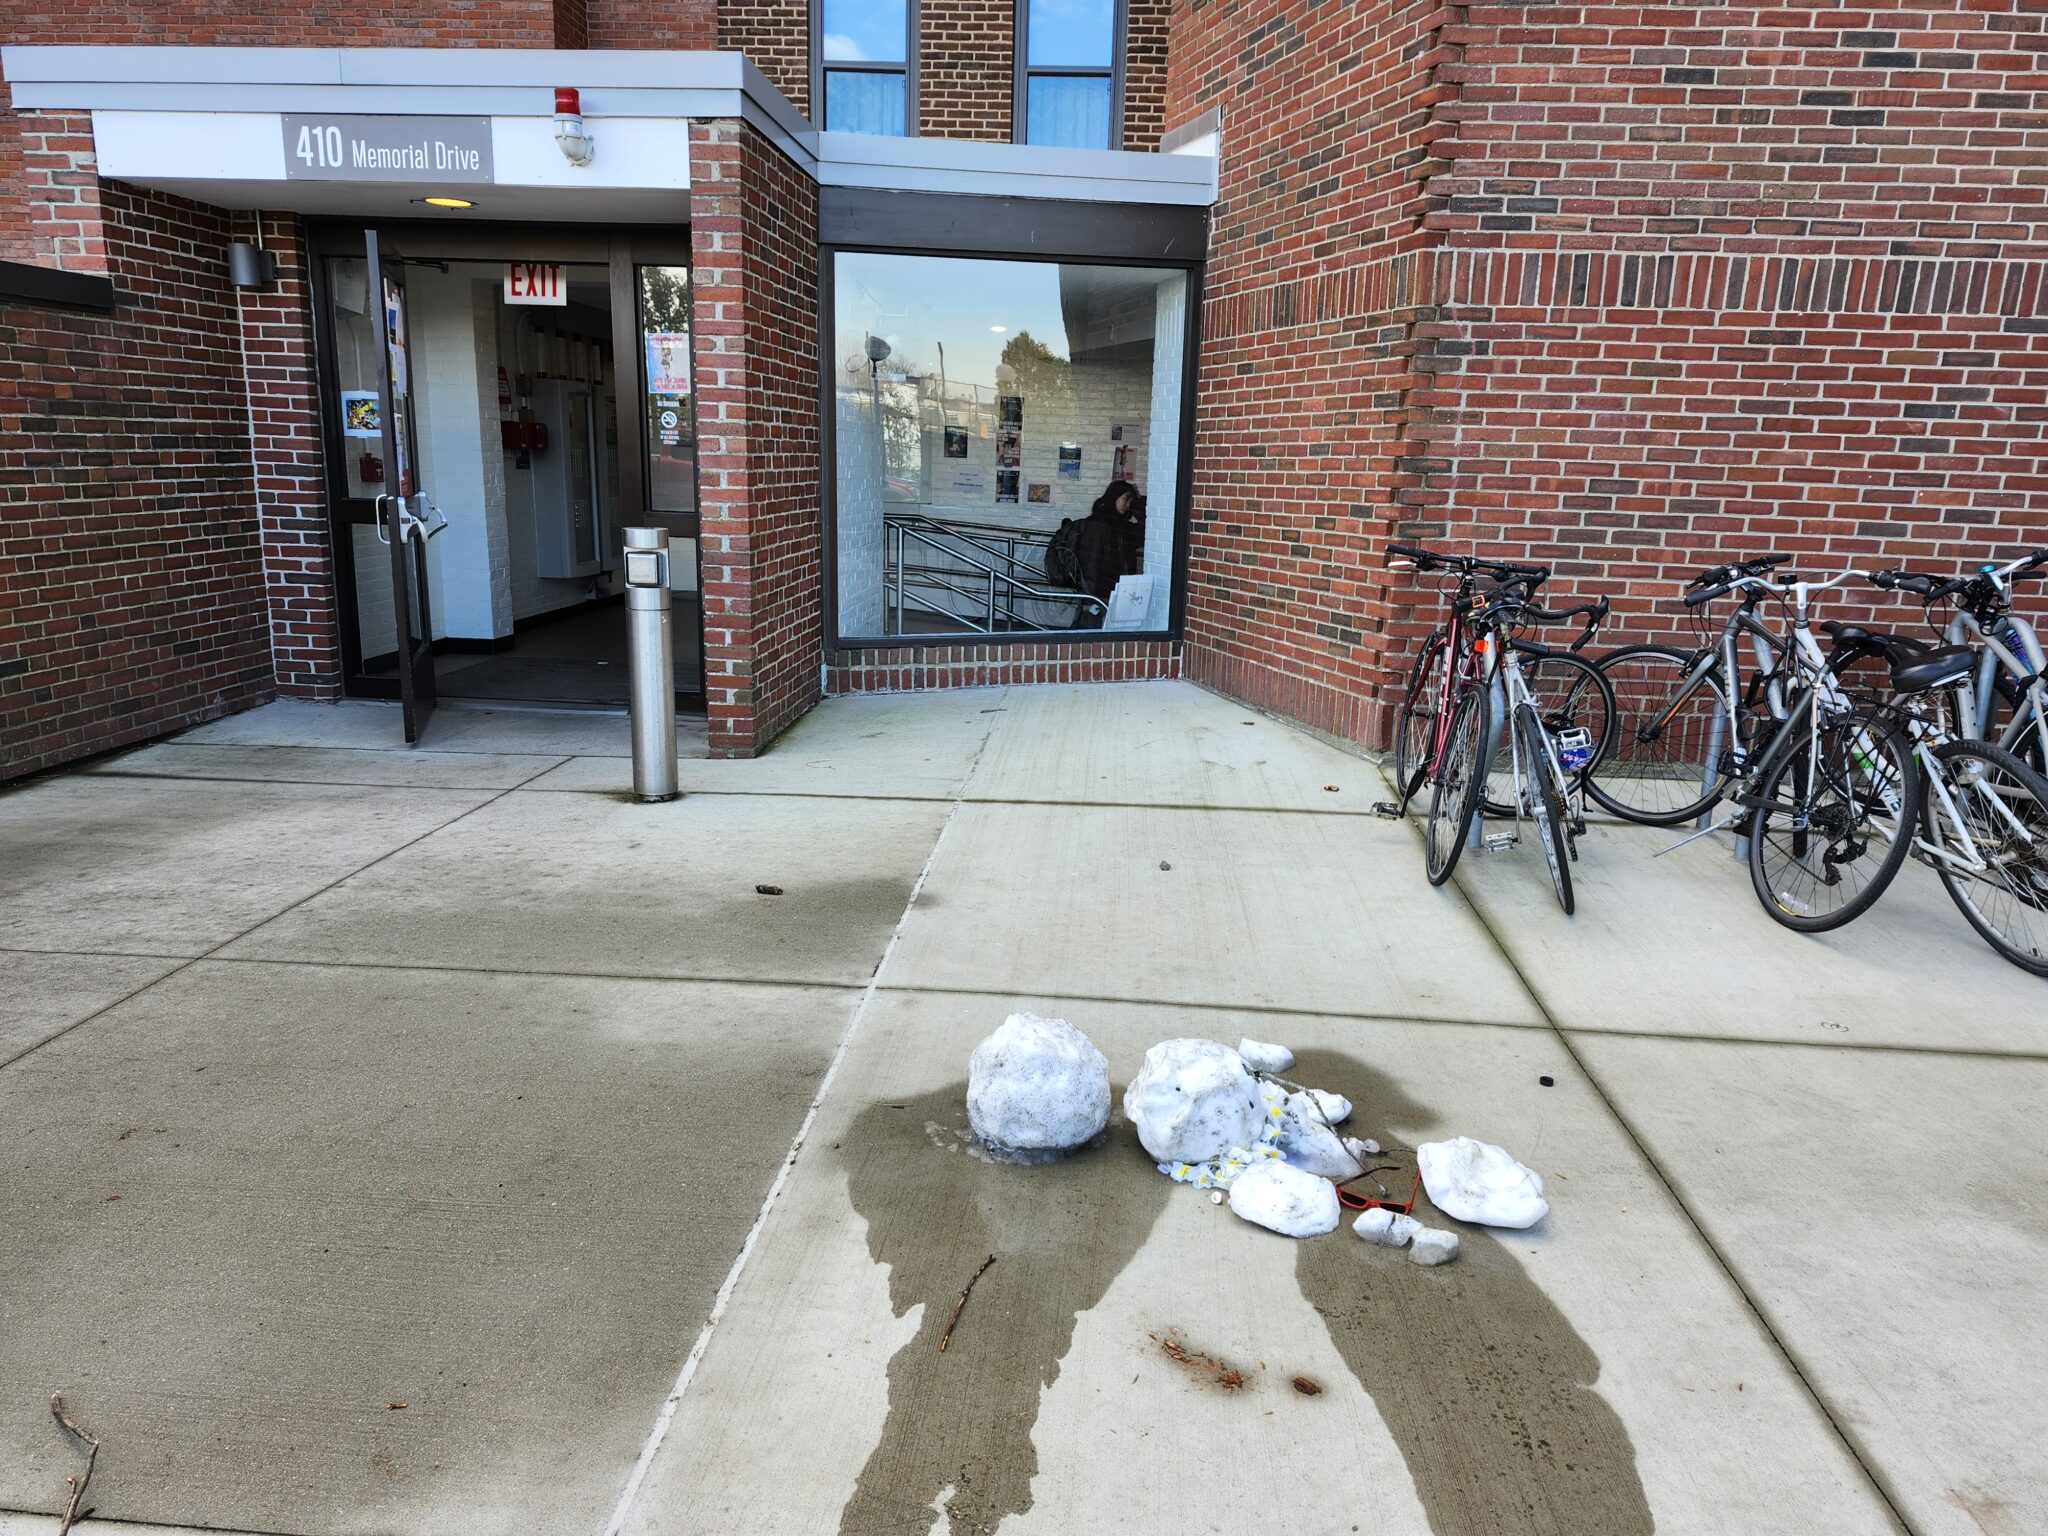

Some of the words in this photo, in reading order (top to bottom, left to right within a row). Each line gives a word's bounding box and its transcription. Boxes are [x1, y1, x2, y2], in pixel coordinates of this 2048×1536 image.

[296, 125, 343, 167] 410
[352, 140, 429, 168] Memorial
[435, 141, 480, 170] Drive
[511, 263, 560, 297] EXIT
